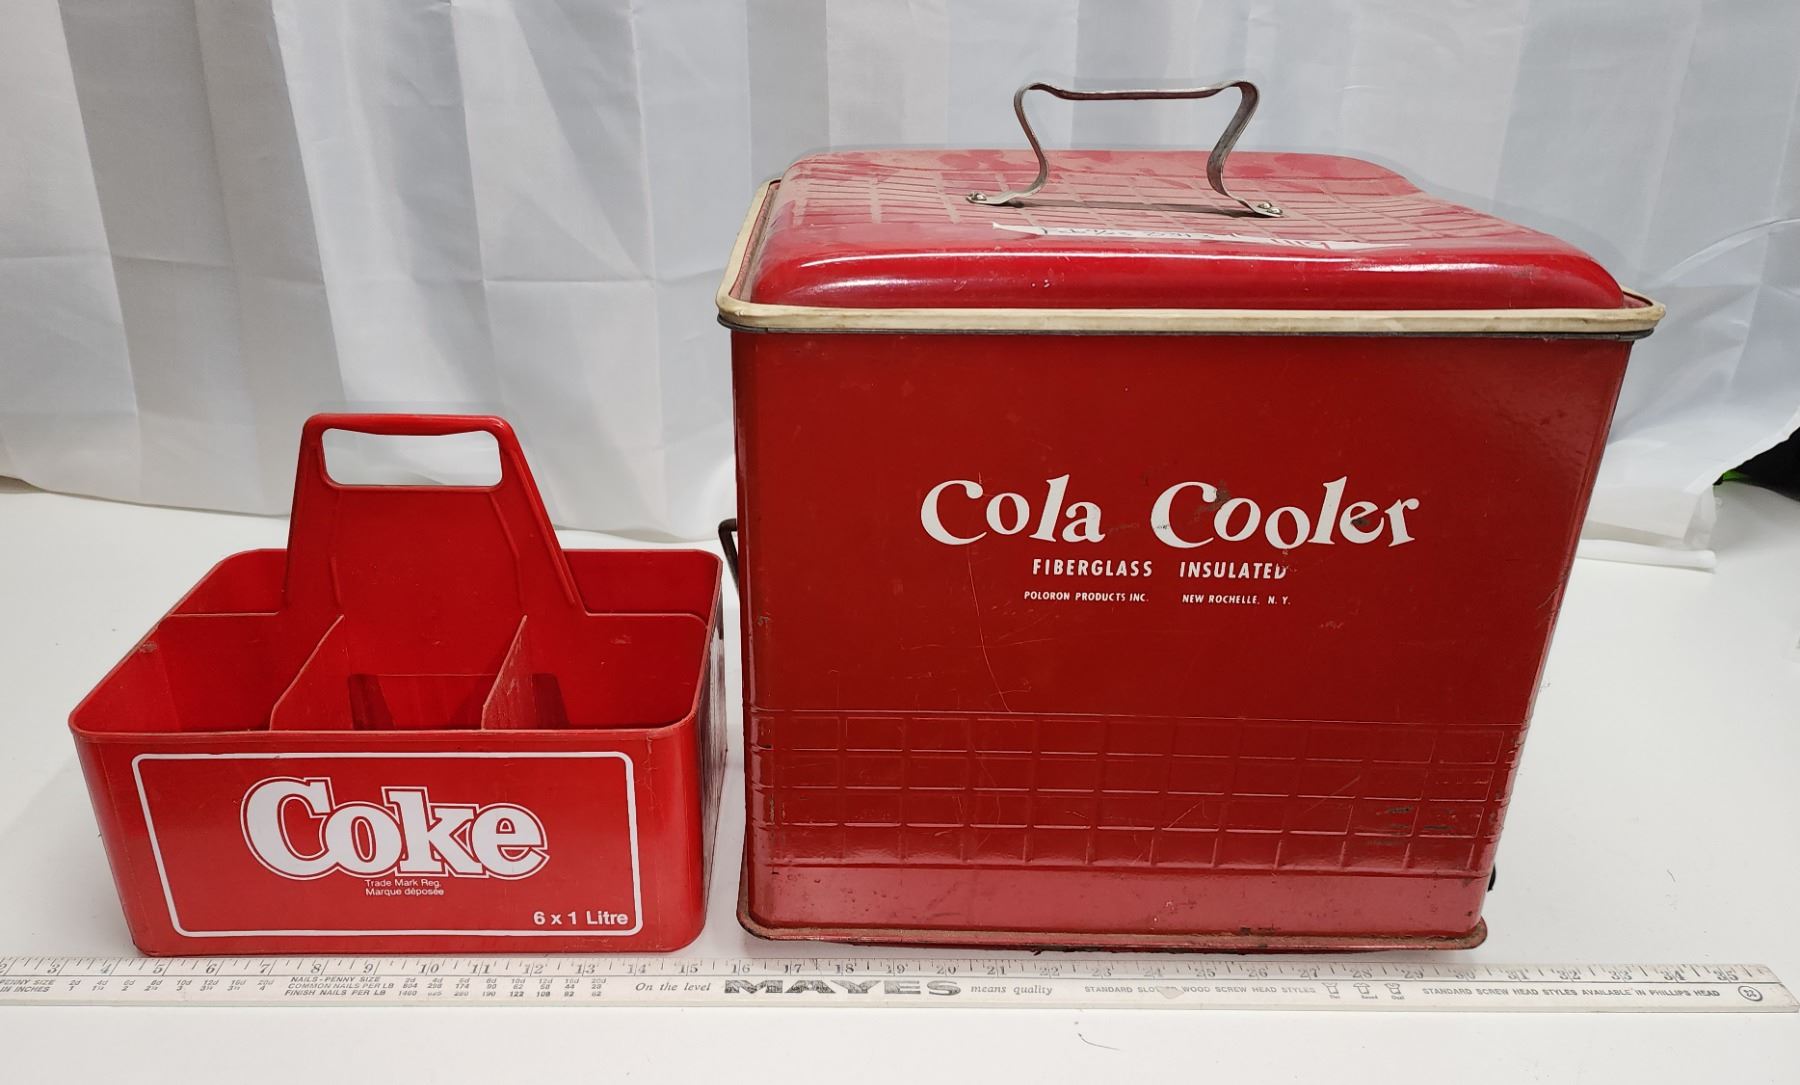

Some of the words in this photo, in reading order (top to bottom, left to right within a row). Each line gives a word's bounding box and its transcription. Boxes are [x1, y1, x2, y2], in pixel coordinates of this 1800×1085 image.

[920, 474, 1106, 546] Cola
[1150, 475, 1420, 550] Cooler
[1032, 558, 1153, 577] FIBERGLASS
[1179, 561, 1288, 580] INSULATED
[1024, 591, 1070, 601] POLORON
[1075, 592, 1126, 602] PRODUCTS
[1129, 593, 1149, 603] INC.
[1182, 594, 1204, 604] NEW
[1268, 596, 1278, 605] N.
[1282, 596, 1291, 605] Y.
[240, 776, 550, 881] Coke
[365, 879, 392, 887] Trade
[394, 879, 419, 888] Mark
[365, 888, 402, 897] Marque
[404, 887, 445, 897] déposée
[533, 911, 546, 925] 6
[551, 914, 562, 925] x
[568, 911, 577, 925] 1
[587, 911, 629, 925] Litre
[47, 963, 61, 974] 3
[99, 963, 113, 974] 4
[152, 963, 166, 974] 5
[205, 963, 218, 974] 6
[259, 963, 271, 974] 7
[310, 963, 323, 974] 8
[362, 963, 374, 974] 9
[419, 963, 440, 974] 10
[471, 963, 490, 974] 11
[522, 963, 544, 974] 12
[575, 963, 596, 974] 13
[627, 963, 647, 974] 14
[679, 963, 699, 974] 15
[731, 963, 751, 974] 16
[784, 963, 802, 974] 17
[834, 963, 855, 974] 18
[886, 963, 906, 974] 19
[936, 964, 957, 975] 20
[986, 965, 1007, 975] 21
[1039, 966, 1060, 977] 22
[635, 982, 654, 992] On
[660, 980, 677, 992] the
[684, 980, 711, 992] level
[724, 979, 962, 996] MAYES
[970, 985, 1007, 994] means
[1012, 984, 1053, 996] quality
[1282, 986, 1316, 994] STYLES
[1422, 987, 1473, 995] STANDARD
[1476, 988, 1509, 996] SCREW
[1513, 988, 1539, 996] HEAD
[1542, 988, 1578, 996] STYLES
[1582, 988, 1631, 997] AVAILABLE
[1635, 989, 1647, 997] IN
[1650, 989, 1692, 997] PHILLIPS
[1694, 989, 1721, 997] HEAD
